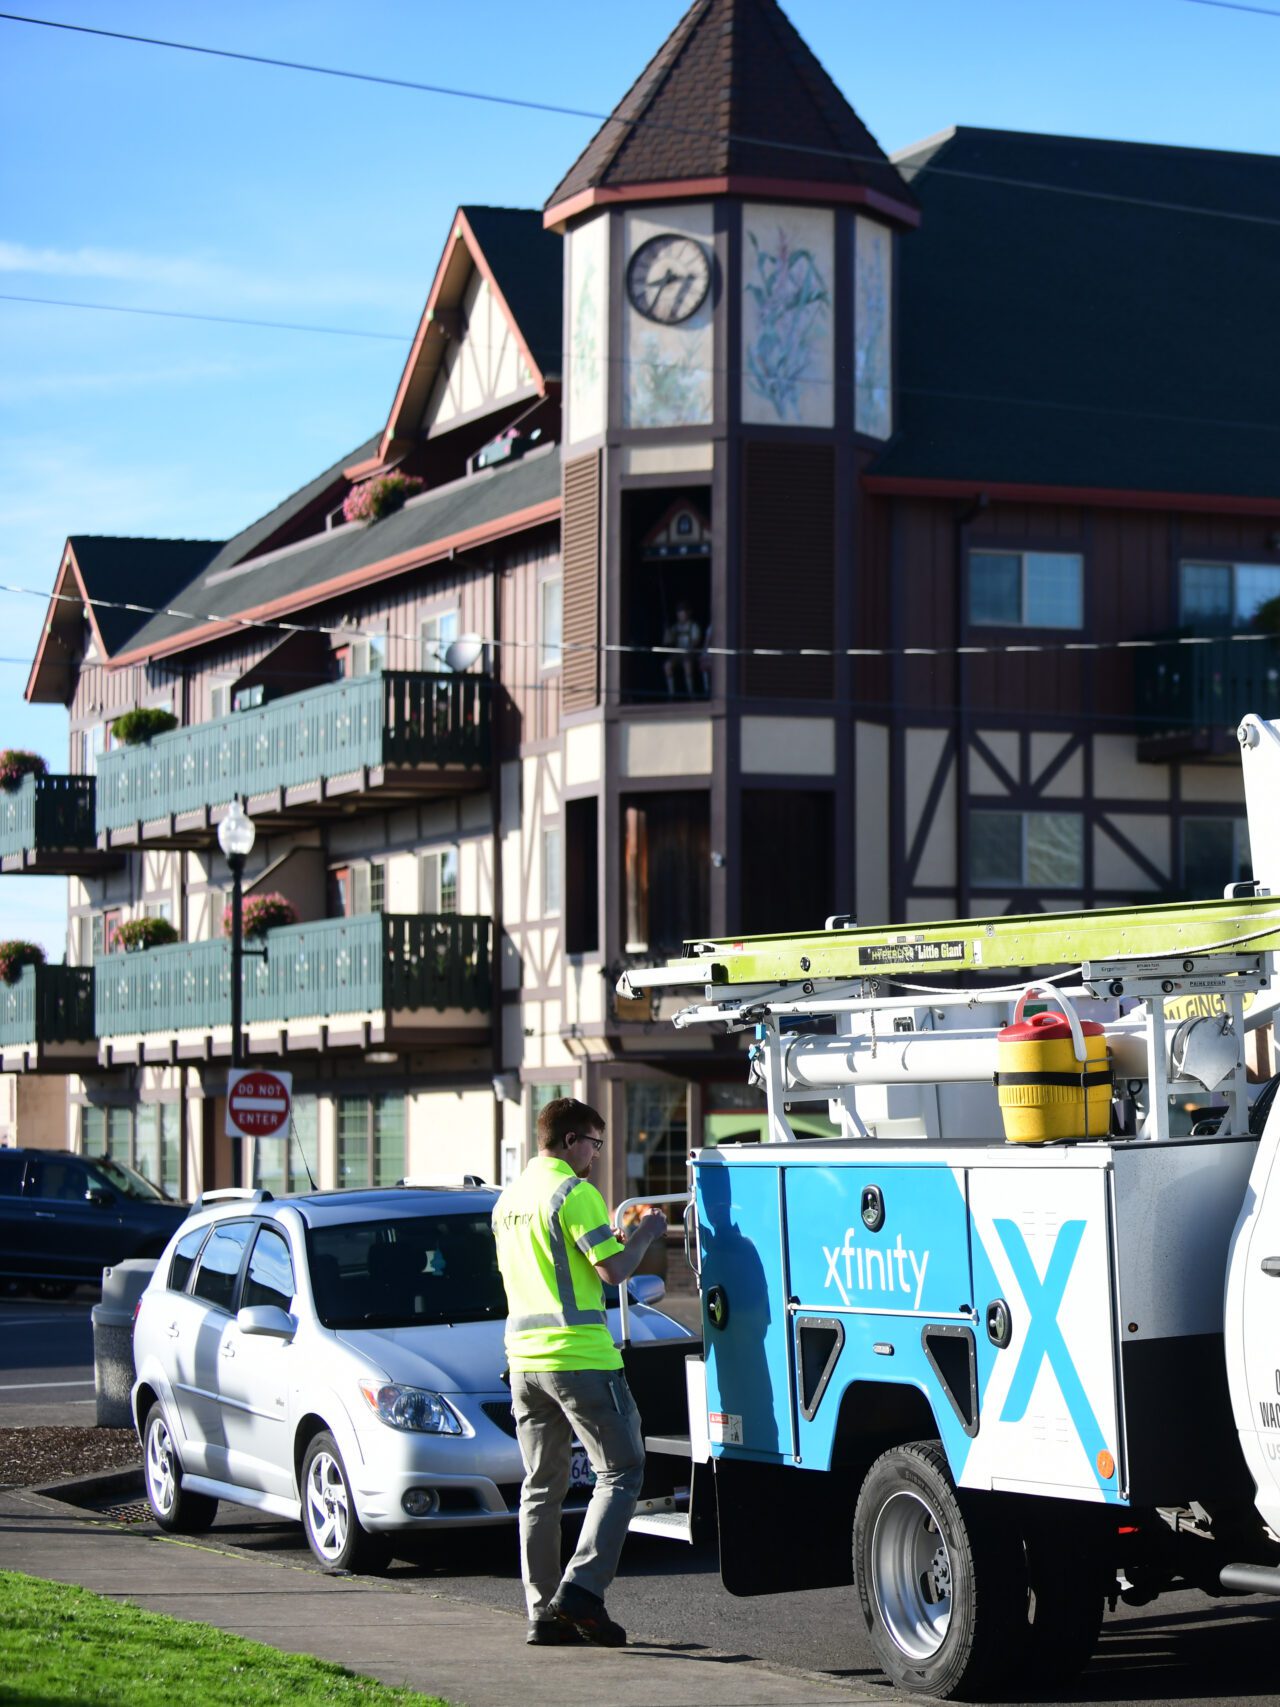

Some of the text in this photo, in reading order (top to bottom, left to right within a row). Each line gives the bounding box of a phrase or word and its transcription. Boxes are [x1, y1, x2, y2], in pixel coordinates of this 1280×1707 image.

[918, 944, 939, 960] Little
[941, 942, 963, 958] Giant
[238, 1083, 281, 1096] DO NOT
[239, 1112, 278, 1126] ENTER
[822, 1228, 929, 1310] xfinity
